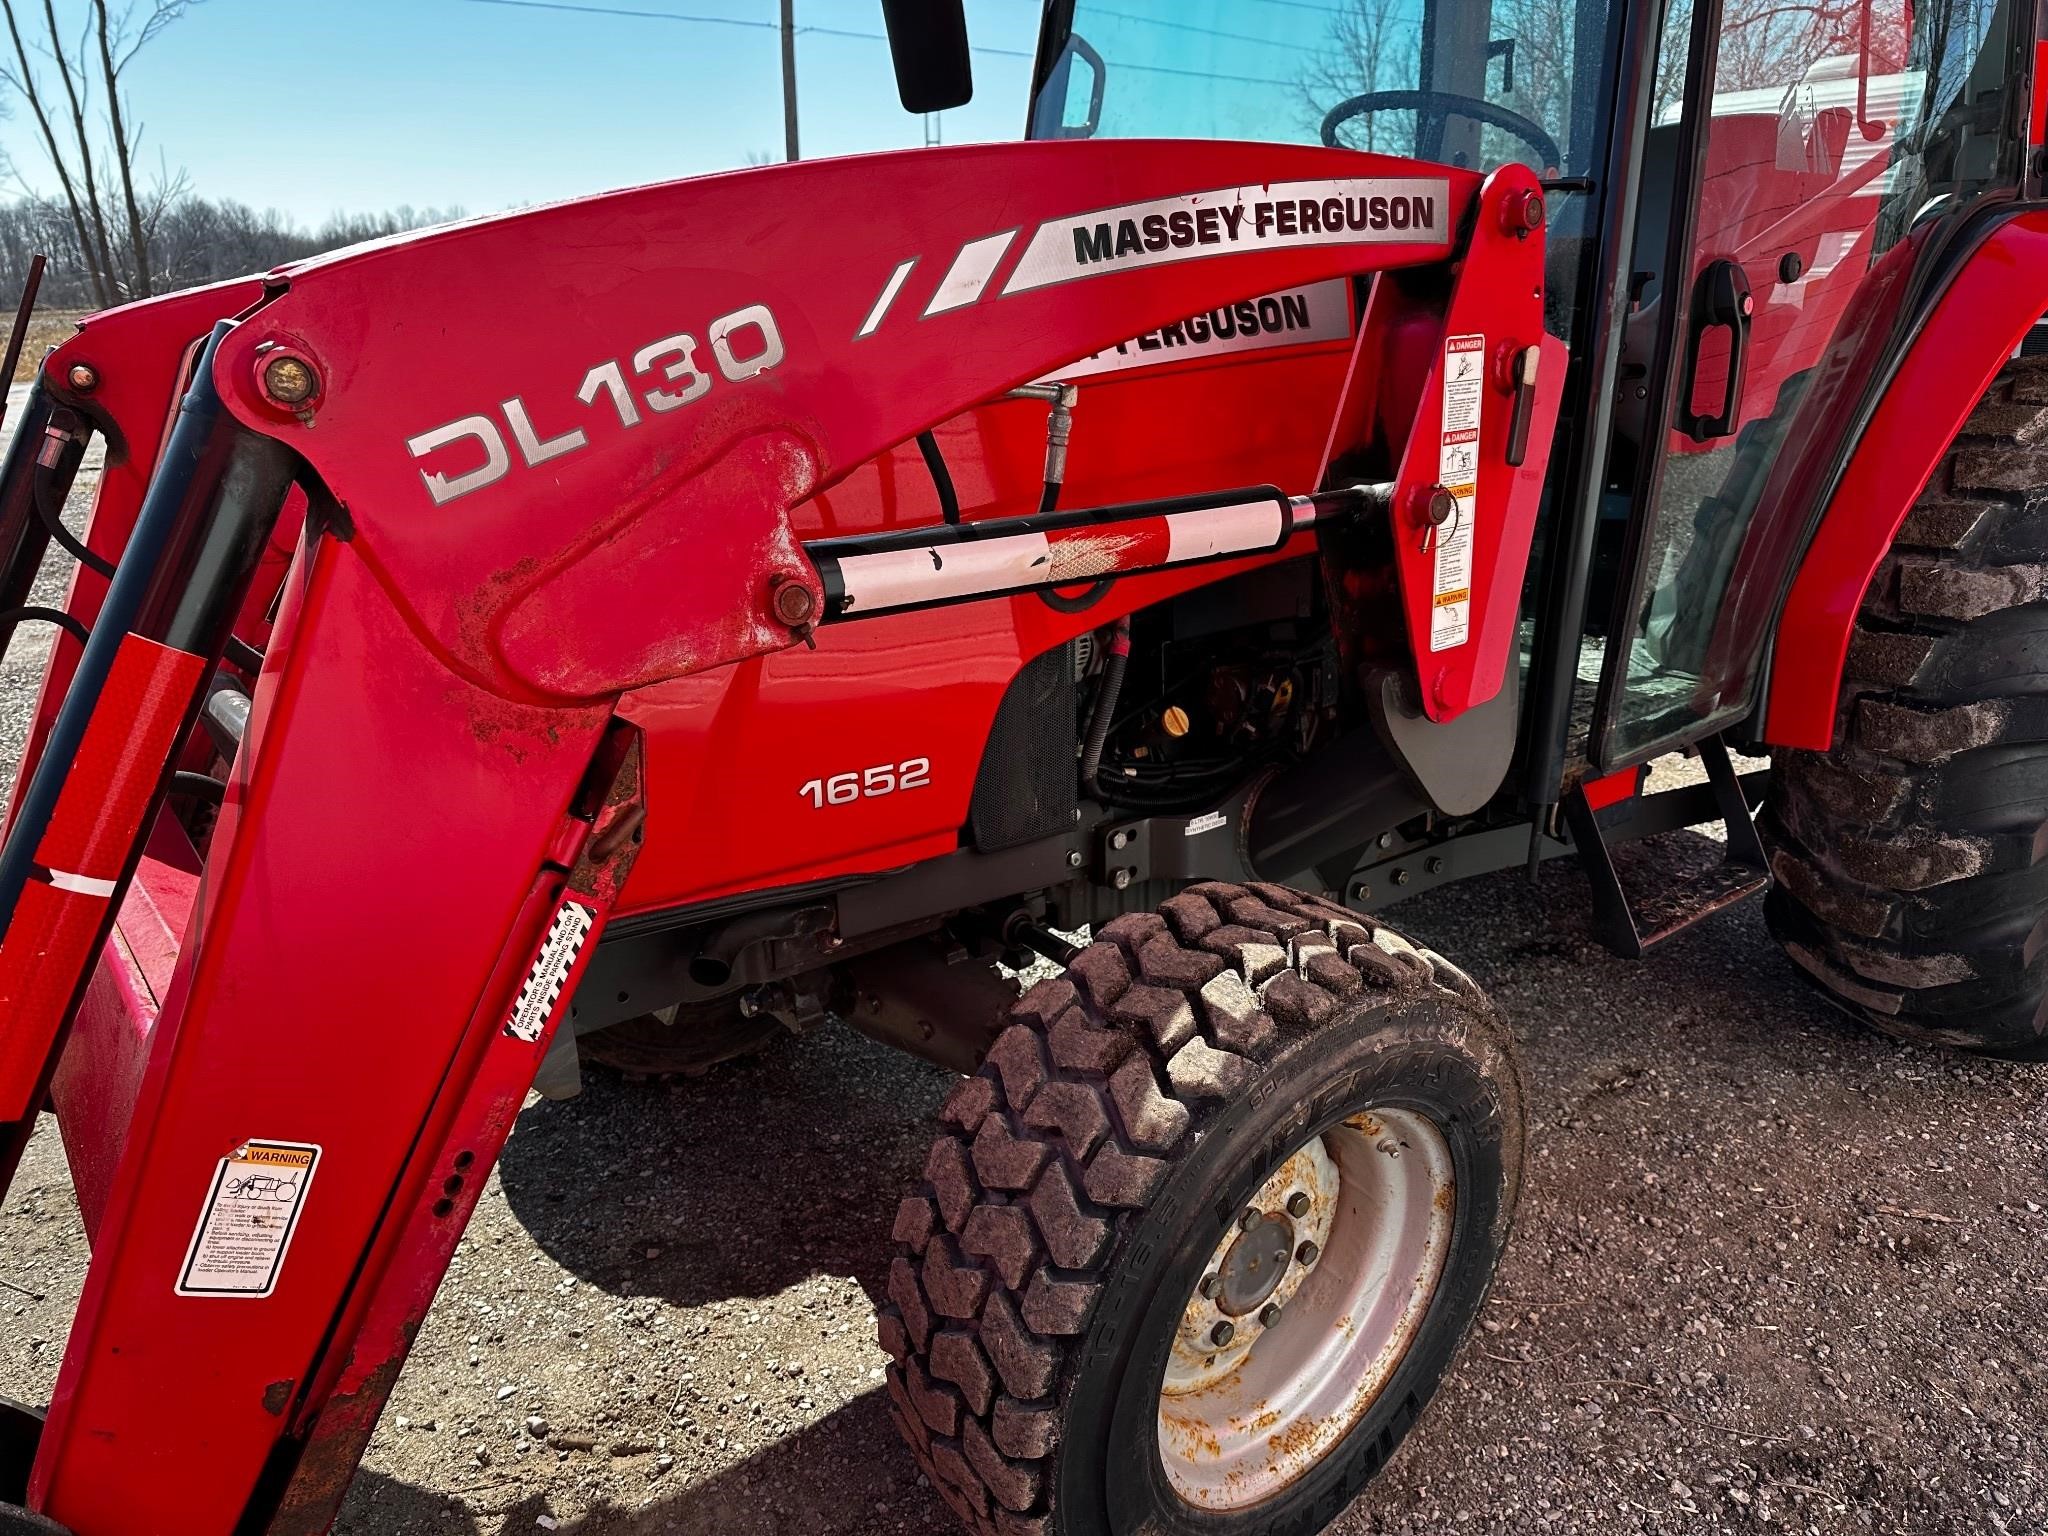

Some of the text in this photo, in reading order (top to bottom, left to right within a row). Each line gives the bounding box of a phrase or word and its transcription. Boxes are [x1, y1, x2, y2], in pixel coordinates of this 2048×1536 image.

[1073, 196, 1434, 264] MASSEY FERGUSON
[1116, 295, 1312, 354] ERGUSON
[1456, 340, 1482, 350] DANGER
[406, 303, 786, 507] DL130
[1451, 431, 1477, 442] DANGER
[1442, 591, 1466, 603] WARNING
[799, 757, 931, 809] 1652
[517, 915, 574, 1028] OPERATOR'S MANUAL AND/OR
[525, 918, 581, 1030] PARTS INSIDE PARKING STAND
[250, 1150, 310, 1165] WARNING
